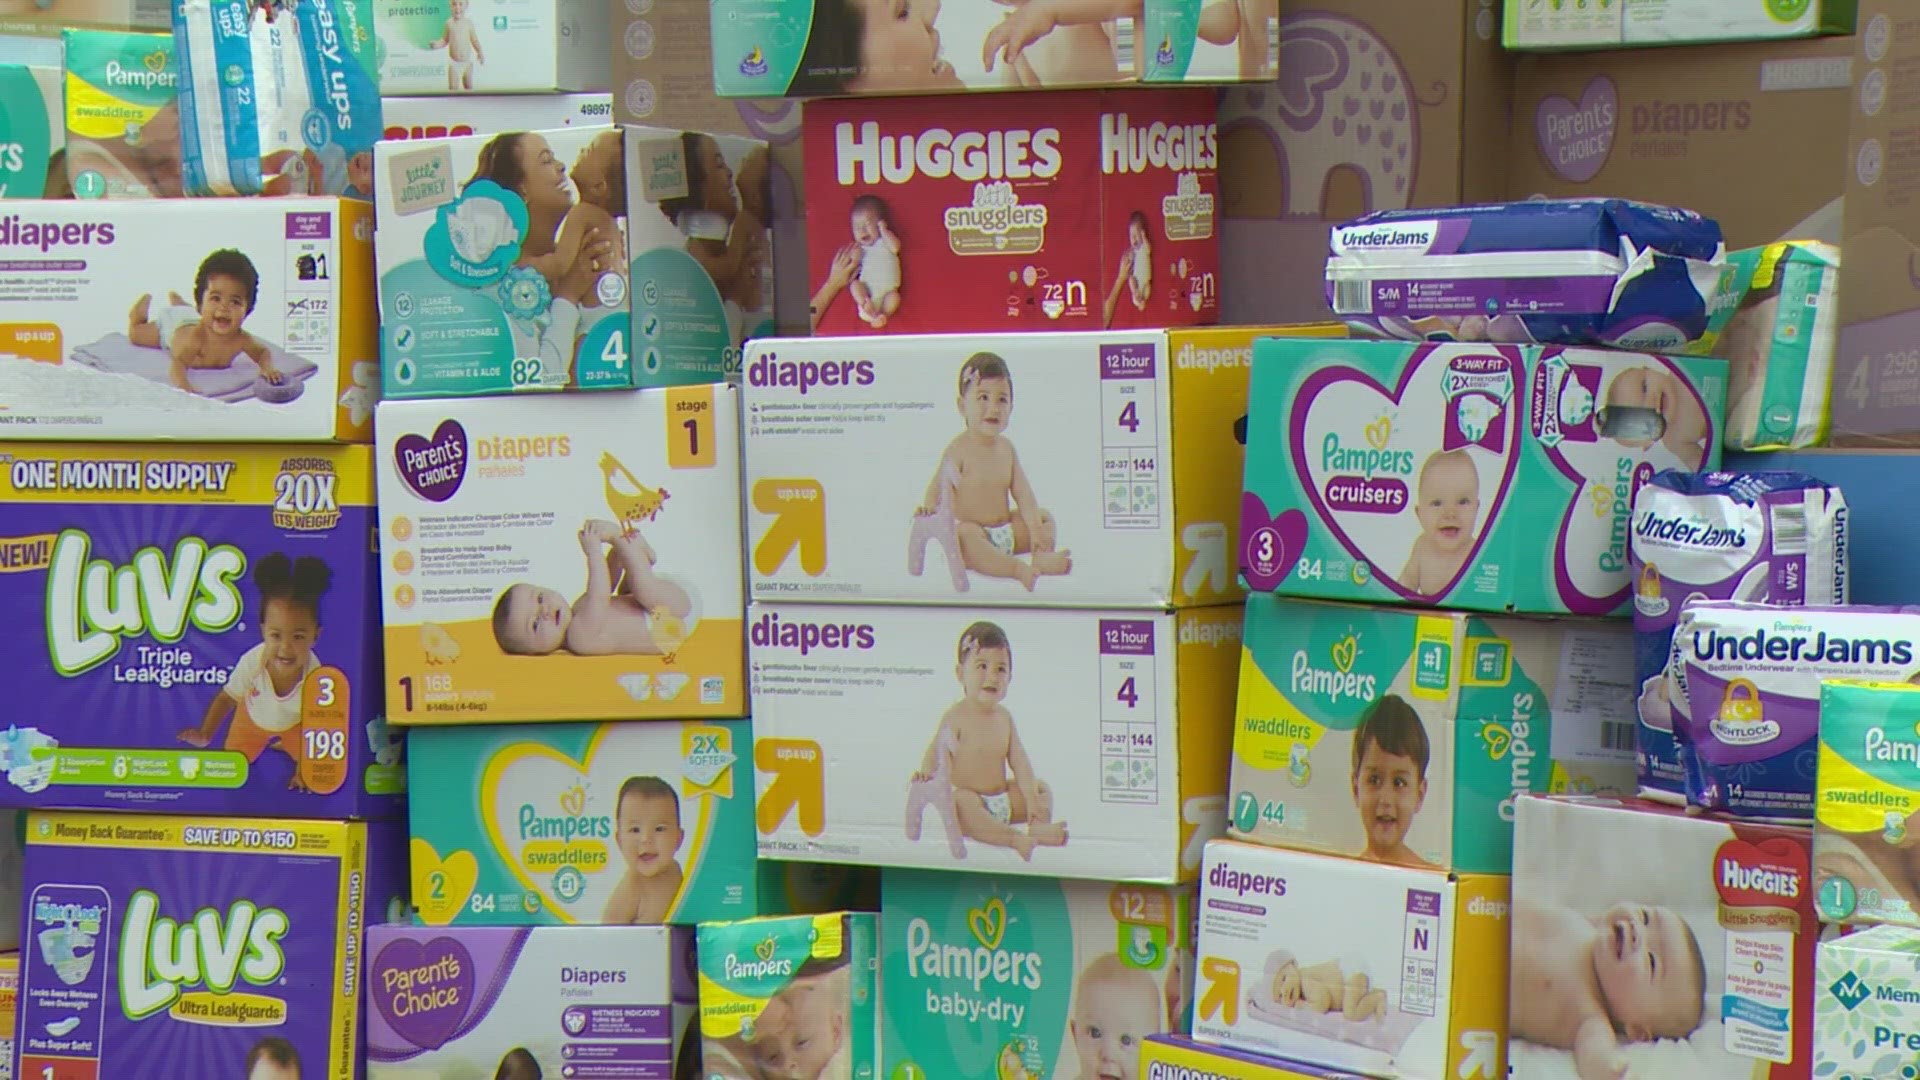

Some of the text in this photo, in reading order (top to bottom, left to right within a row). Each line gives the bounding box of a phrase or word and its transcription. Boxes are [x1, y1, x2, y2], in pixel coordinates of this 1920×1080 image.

[230, 3, 248, 38] easy
[388, 5, 440, 17] protection
[219, 9, 233, 38] ups
[270, 28, 281, 49] 22
[106, 60, 178, 90] Pamper
[237, 87, 250, 105] 22
[331, 71, 352, 131] ups
[76, 105, 144, 119] swaddlers
[580, 104, 611, 116] 49897
[1631, 100, 1751, 135] Diapers
[836, 121, 1062, 185] HUGGIES
[1102, 114, 1217, 174] HUGGIES
[1559, 135, 1607, 165] CHOICE
[85, 174, 94, 192] 1
[400, 182, 447, 202] JOURNEY
[1164, 197, 1213, 217] snugglers
[946, 207, 1046, 233] snugglers
[0, 216, 115, 251] diapers
[1342, 230, 1429, 248] UnderJams
[646, 288, 656, 298] 12
[1043, 285, 1063, 299] 72
[1190, 277, 1202, 291] 72
[1378, 287, 1400, 300] S/M
[1407, 283, 1420, 297] 14
[310, 300, 328, 310] 172
[398, 300, 410, 311] 12
[448, 327, 500, 339] STRETCHABLE
[601, 330, 628, 369] 4
[724, 349, 743, 373] 82
[1106, 355, 1150, 368] 12 hour
[1177, 344, 1252, 373] diapers
[513, 360, 542, 384] 82
[749, 352, 875, 394] diapers
[1456, 359, 1503, 371] 3-WAY FIT
[1120, 386, 1136, 394] SIZE
[1451, 375, 1469, 390] 2X
[1846, 355, 1870, 409] 4
[676, 399, 708, 413] stage
[1532, 371, 1545, 429] 3-WAY FIT
[16, 416, 37, 424] PACK
[1118, 401, 1139, 432] 4
[1545, 411, 1557, 435] 2X
[477, 433, 572, 461] Diapers
[684, 419, 698, 456] 1
[281, 458, 333, 472] ABSORBS
[405, 438, 463, 473] Parent's
[1105, 460, 1128, 469] 22-37
[1133, 459, 1154, 470] 144
[1322, 432, 1413, 477] Pampers
[12, 461, 56, 490] ONE
[61, 461, 141, 491] MONTH
[418, 464, 459, 489] CHOICE
[275, 474, 338, 514] 20X
[1329, 482, 1404, 505] cruisers
[276, 514, 339, 529] ITS WEIGHT
[1599, 457, 1634, 574] Pampers
[1636, 511, 1746, 549] UnderJams
[0, 540, 48, 568] NEW!
[1257, 531, 1273, 561] 3
[1833, 507, 1847, 605] UnderJam
[1297, 557, 1324, 580] 84
[1786, 562, 1799, 590] S/M
[756, 583, 800, 592] GIANT PACK
[751, 612, 875, 656] diapers
[1105, 630, 1149, 645] 12 hour
[1179, 618, 1242, 648] diape
[1774, 621, 1812, 633] Pampers
[138, 646, 192, 670] Triple
[1424, 646, 1443, 670] #1
[1694, 629, 1913, 665] UnderJams
[1480, 652, 1496, 673] #1
[1708, 664, 1743, 673] Bedtime
[1745, 663, 1794, 673] Underwear
[114, 665, 228, 689] Leakguards
[425, 674, 453, 692] 168
[1292, 651, 1376, 703] Pampers
[318, 677, 335, 707] 3
[399, 676, 413, 712] 1
[1117, 676, 1138, 708] 4
[304, 729, 346, 761] 198
[693, 735, 719, 754] 2X
[1103, 734, 1126, 744] 22-37
[1131, 733, 1153, 746] 144
[1866, 727, 1920, 767] Pam
[689, 755, 727, 767] SOFTER
[1728, 784, 1743, 797] 14
[1827, 789, 1910, 808] swaddlers
[1240, 795, 1252, 821] 7
[1262, 801, 1285, 825] 44
[56, 823, 87, 841] Money
[91, 824, 112, 838] Back
[519, 804, 611, 842] Pampers
[184, 825, 220, 845] SAVE
[221, 828, 240, 846] UP
[242, 829, 261, 847] TO
[262, 829, 296, 848] $150
[527, 849, 606, 865] swaddlers
[431, 873, 445, 898] 2
[1209, 863, 1287, 897] diapers
[1723, 858, 1799, 897] HUGGIES
[471, 893, 496, 913] 84
[1120, 892, 1145, 920] 12
[1834, 881, 1843, 907] 1
[1724, 912, 1748, 925] Little
[344, 873, 361, 997] SAVE UP TO $150
[1413, 928, 1429, 951] N
[907, 917, 1042, 991] Pampers
[383, 954, 461, 993] Parent's
[561, 967, 627, 984] Diapers
[725, 953, 791, 980] Pampers
[393, 985, 460, 1018] Choice
[1876, 985, 1920, 1003] Mem
[179, 1001, 281, 1021] Ultra Leakguards
[592, 1009, 660, 1017] WETNESS INDICATOR
[704, 1001, 757, 1016] swaddlers
[926, 988, 1025, 1029] baby-dry
[1027, 1038, 1039, 1050] 12
[1217, 1029, 1232, 1039] PACK
[1874, 1025, 1920, 1051] Pre
